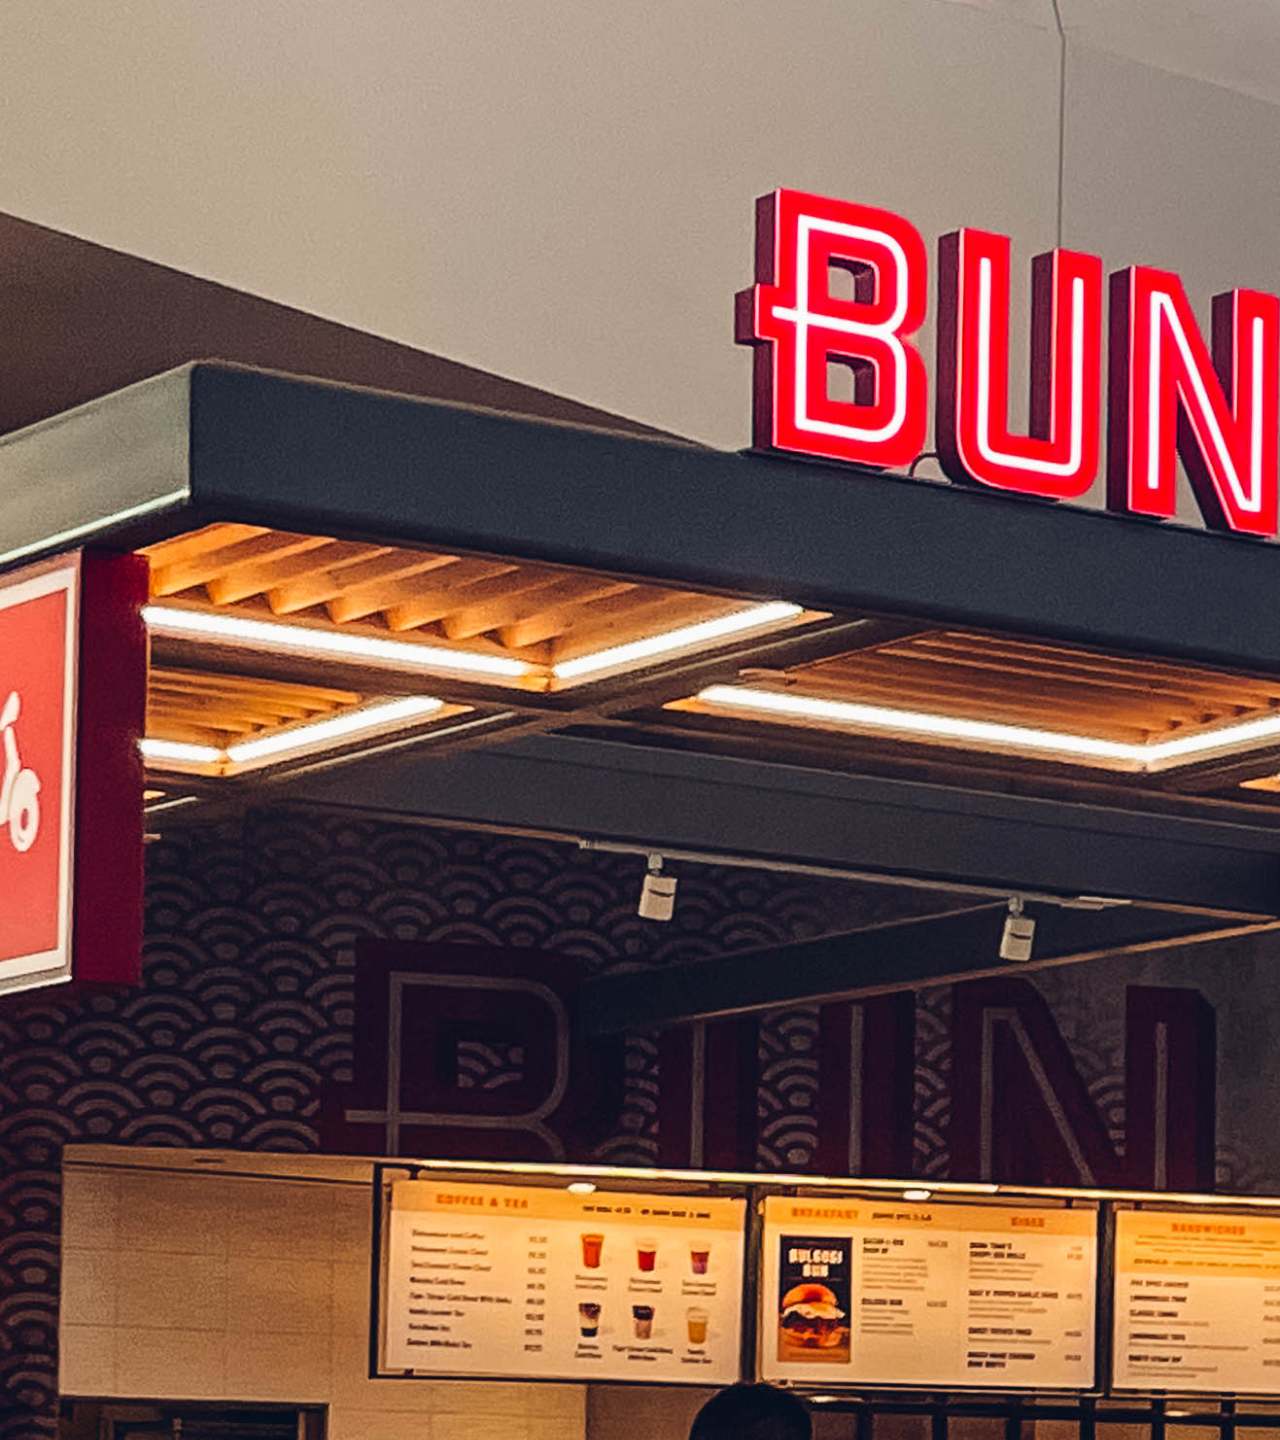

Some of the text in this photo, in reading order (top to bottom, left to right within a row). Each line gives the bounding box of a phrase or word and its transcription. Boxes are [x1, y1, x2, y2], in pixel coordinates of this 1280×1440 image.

[748, 188, 1280, 540] BUN
[792, 1207, 859, 1220] BREAKFAST
[1171, 1223, 1246, 1236] SANDWICHES
